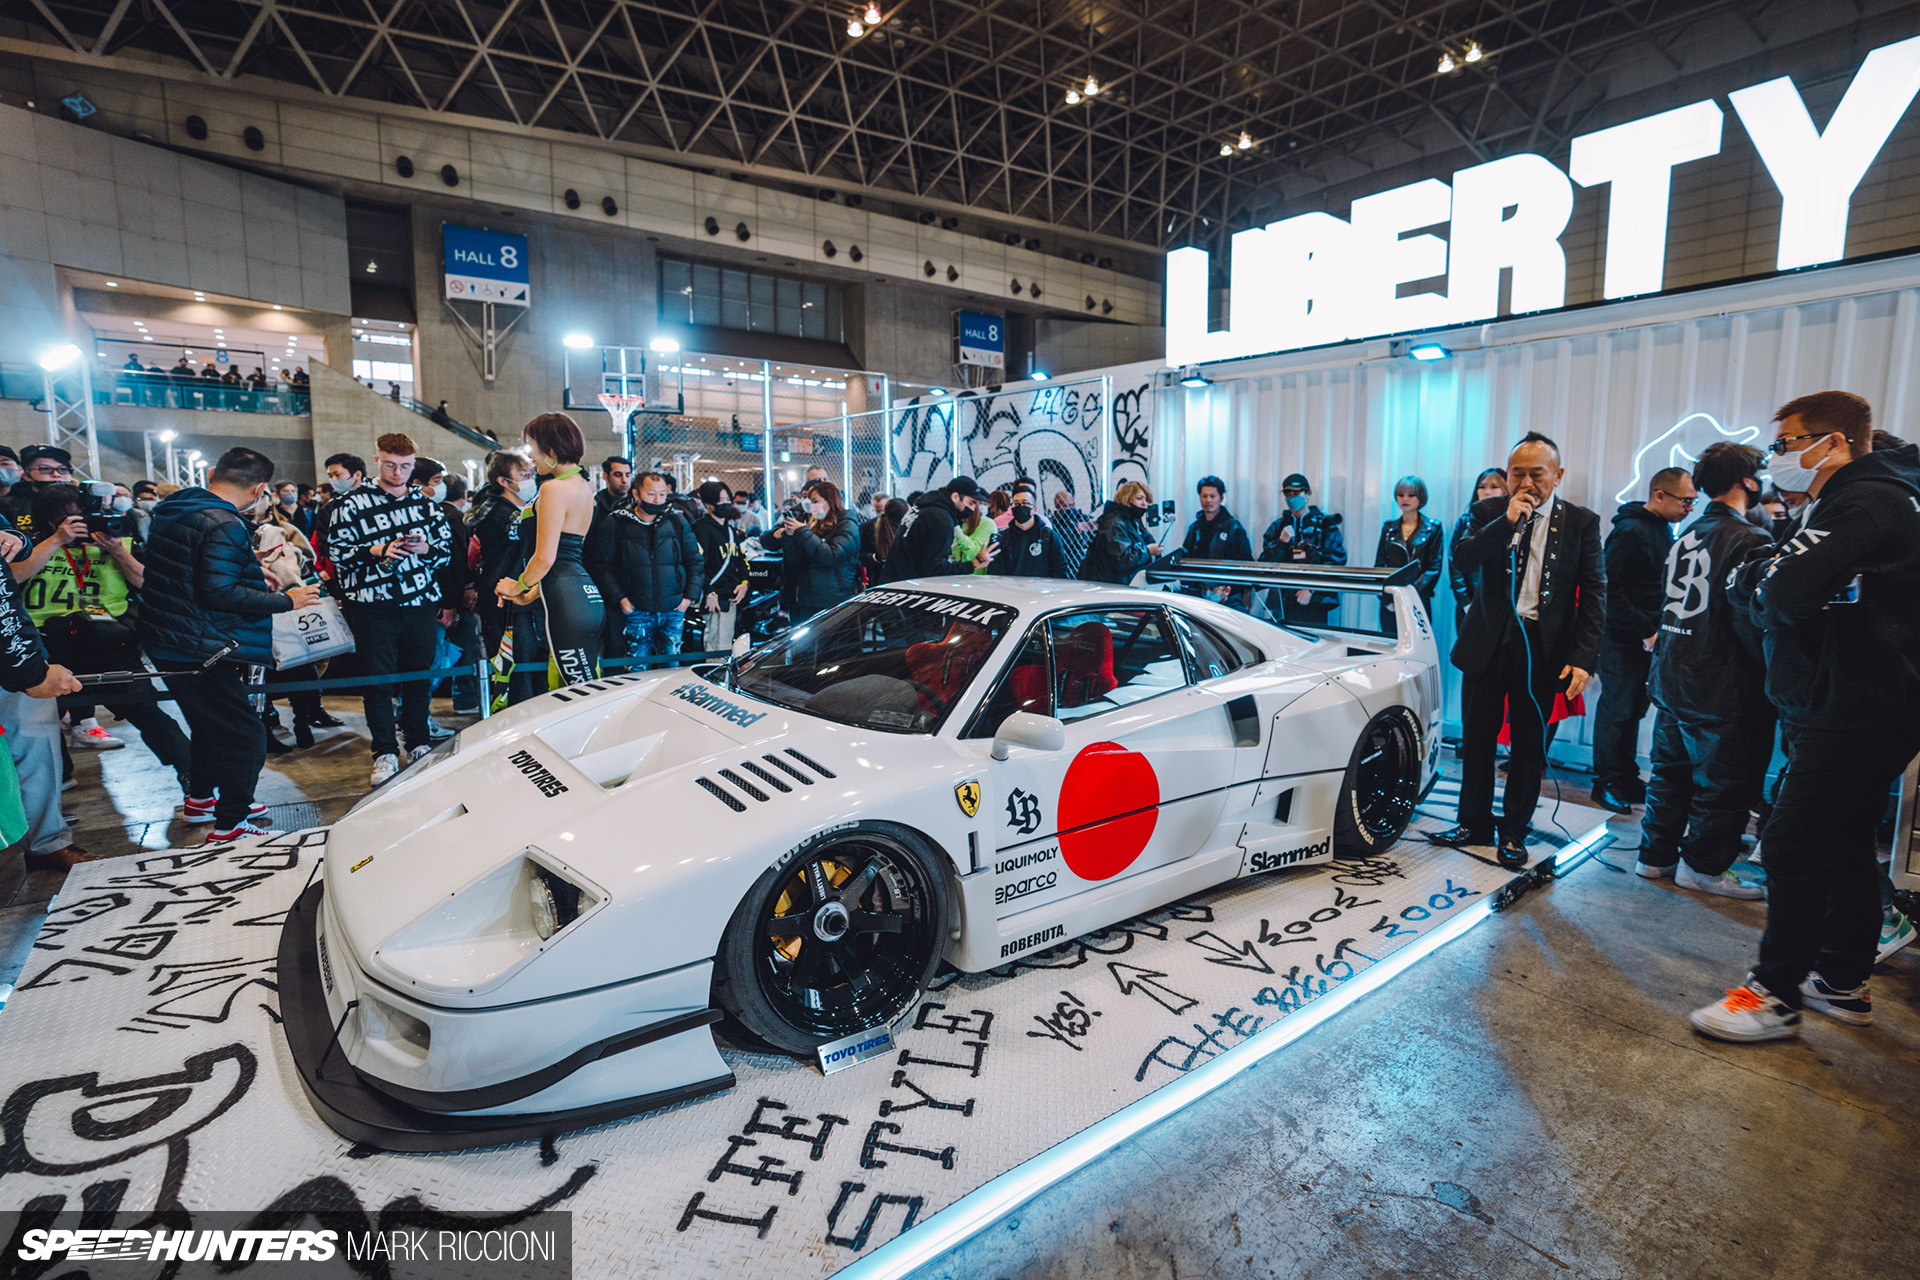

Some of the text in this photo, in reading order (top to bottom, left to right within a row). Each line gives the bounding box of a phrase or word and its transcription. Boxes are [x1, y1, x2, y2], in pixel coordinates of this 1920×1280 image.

[1166, 37, 1920, 368] LIBERTY
[454, 245, 519, 269] HALL 8
[965, 324, 999, 342] HALL 8
[216, 350, 229, 363] 8
[924, 598, 1007, 626] WALK
[670, 682, 767, 729] #Slammed
[508, 750, 569, 798] TOYO TIRES
[1250, 840, 1330, 873] Slammed
[995, 871, 1057, 904] sparco
[824, 1033, 890, 1064] TOYO TIRES
[825, 1001, 995, 1252] STYLE
